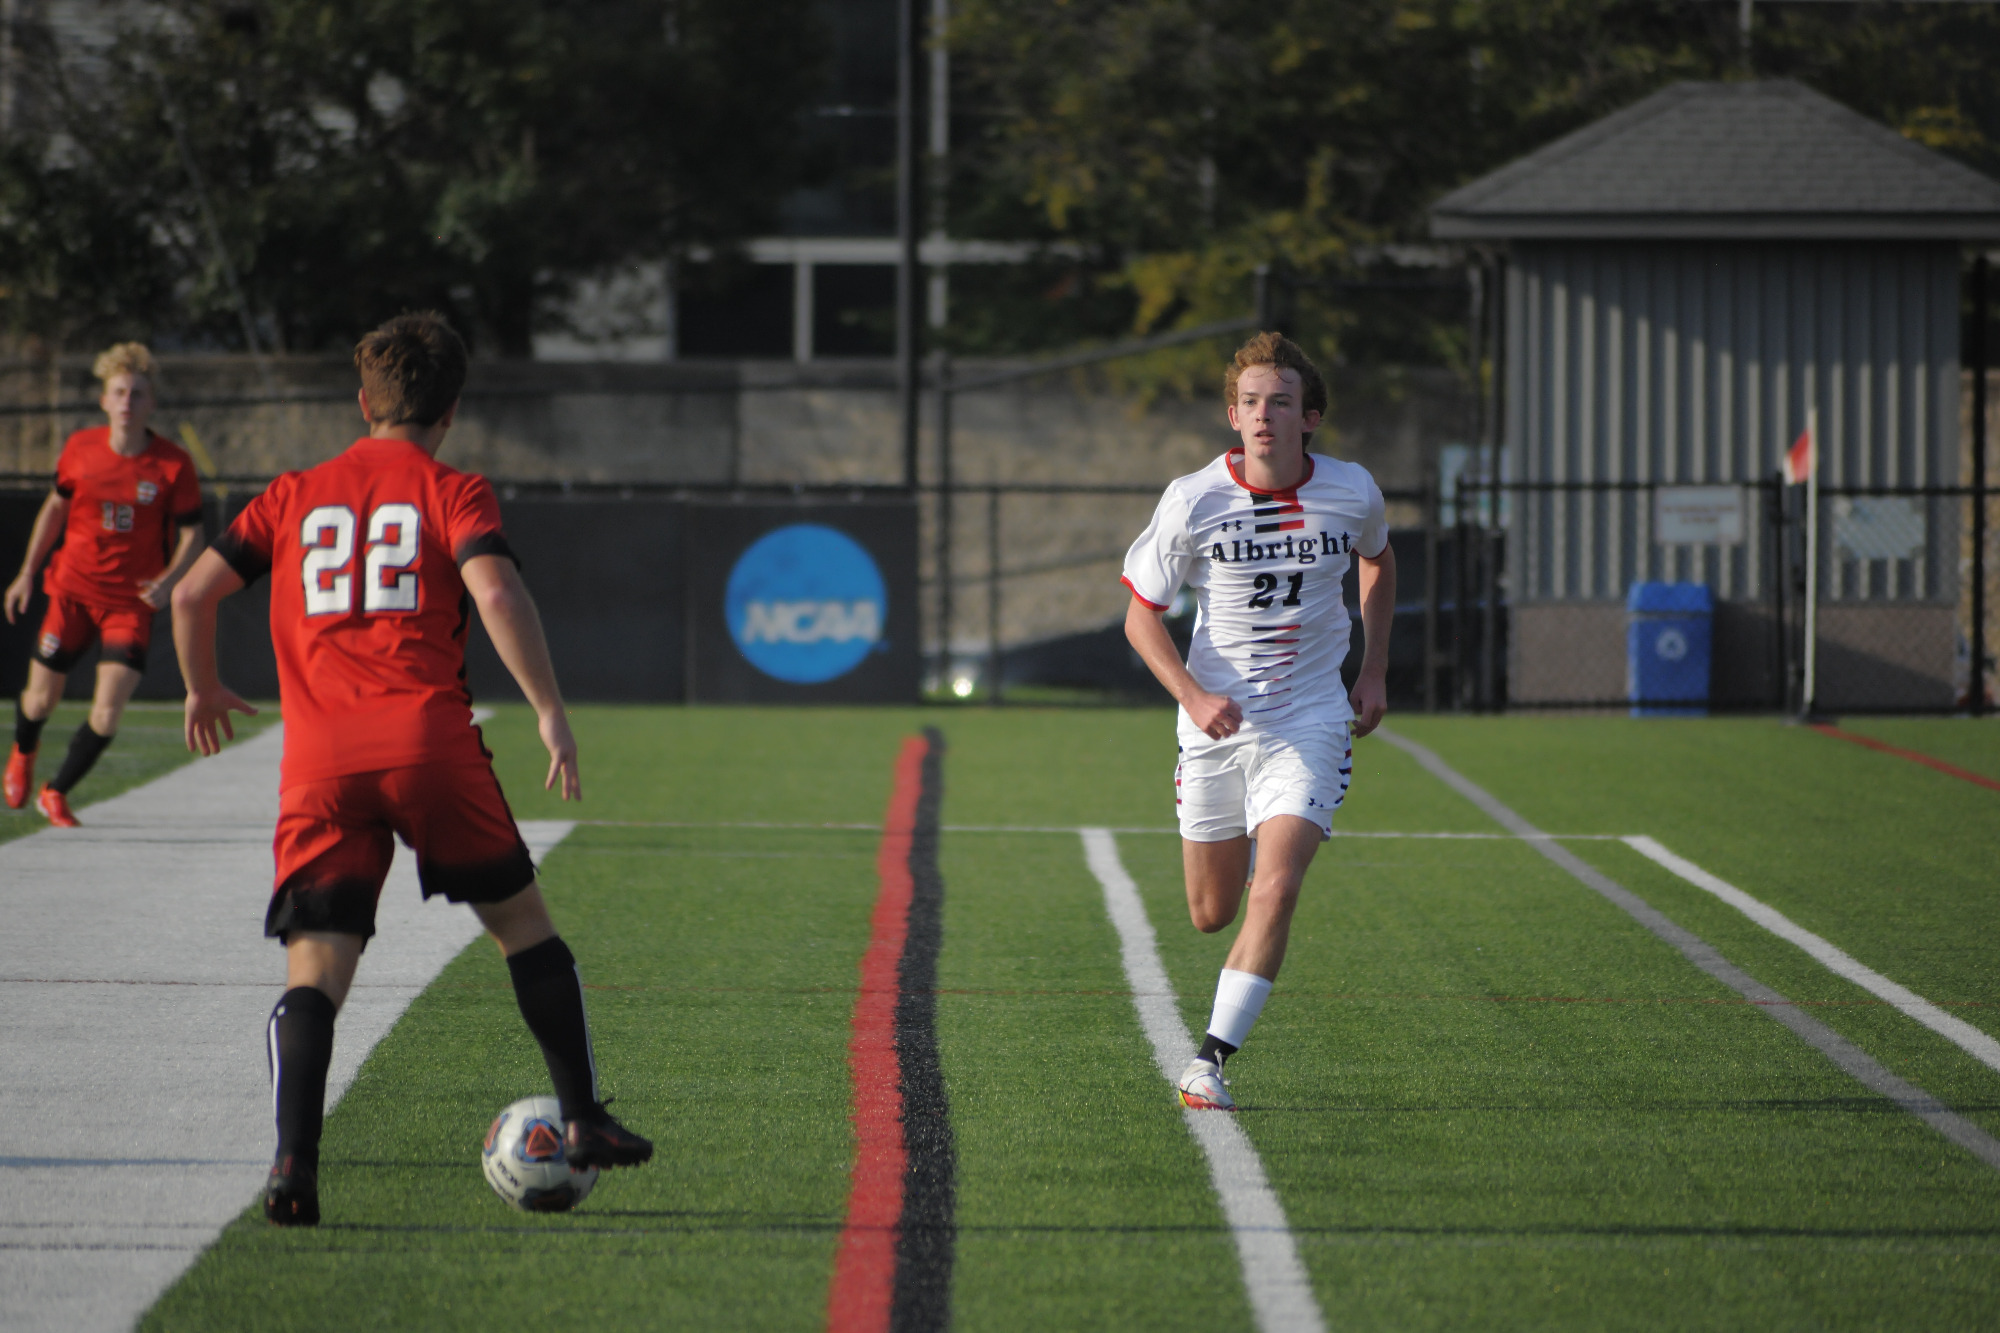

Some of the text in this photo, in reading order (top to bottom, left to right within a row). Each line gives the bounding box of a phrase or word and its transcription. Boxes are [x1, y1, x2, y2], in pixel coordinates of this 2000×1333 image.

[301, 503, 421, 618] 22
[1210, 531, 1351, 564] Albright
[1249, 572, 1304, 608] 21
[742, 600, 881, 643] NCAA
